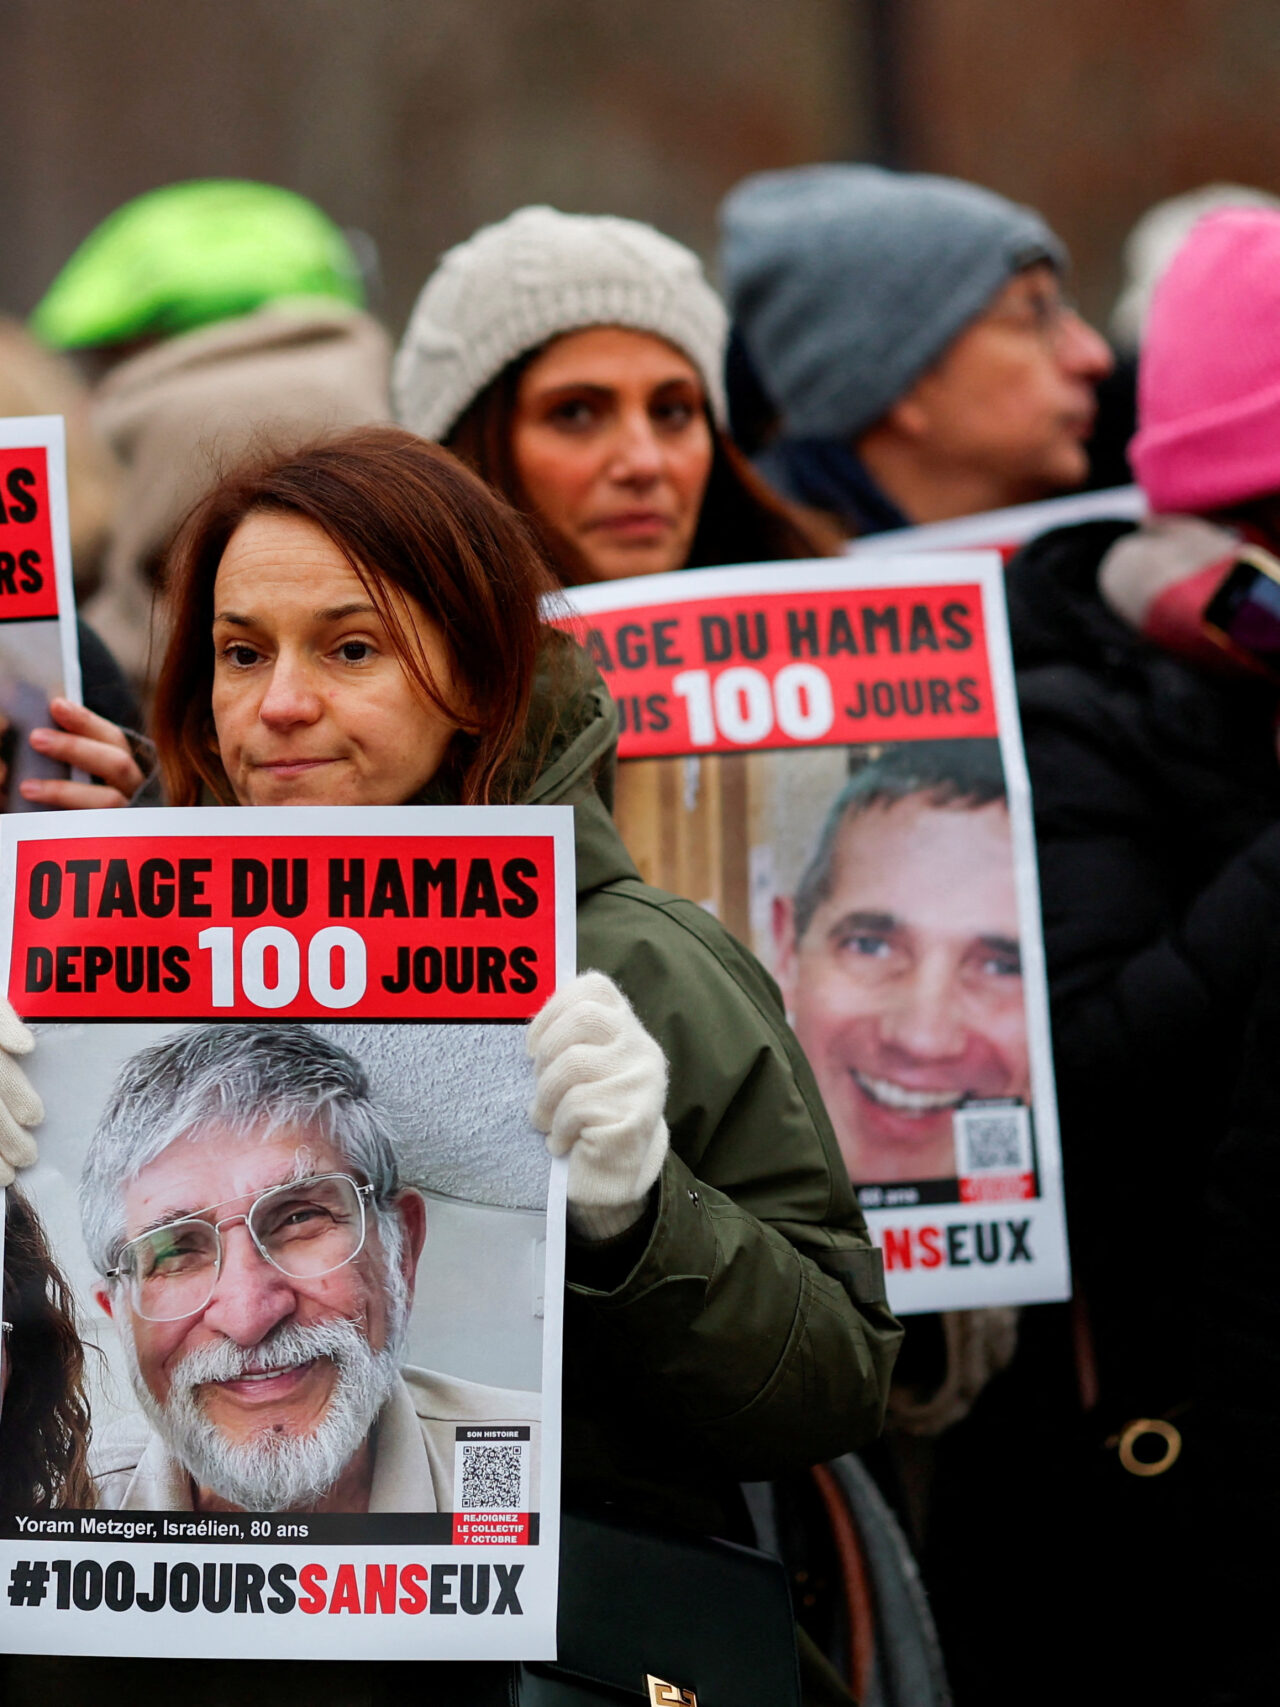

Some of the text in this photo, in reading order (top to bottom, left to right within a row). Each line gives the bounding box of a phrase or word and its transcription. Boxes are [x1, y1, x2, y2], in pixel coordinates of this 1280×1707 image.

[585, 603, 973, 672] AGE DU HAMAS
[673, 663, 834, 746] 100
[846, 678, 980, 720] JOURS
[28, 857, 539, 919] OTAGE DU HAMAS
[25, 925, 538, 1009] DEPUIS 100 JOURS
[15, 1516, 309, 1539] Yoram Metzger, Israélien, 80 ans
[464, 1514, 518, 1522] REJOIGNEZ
[7, 1559, 525, 1615] #100JOURSSANSEUX
